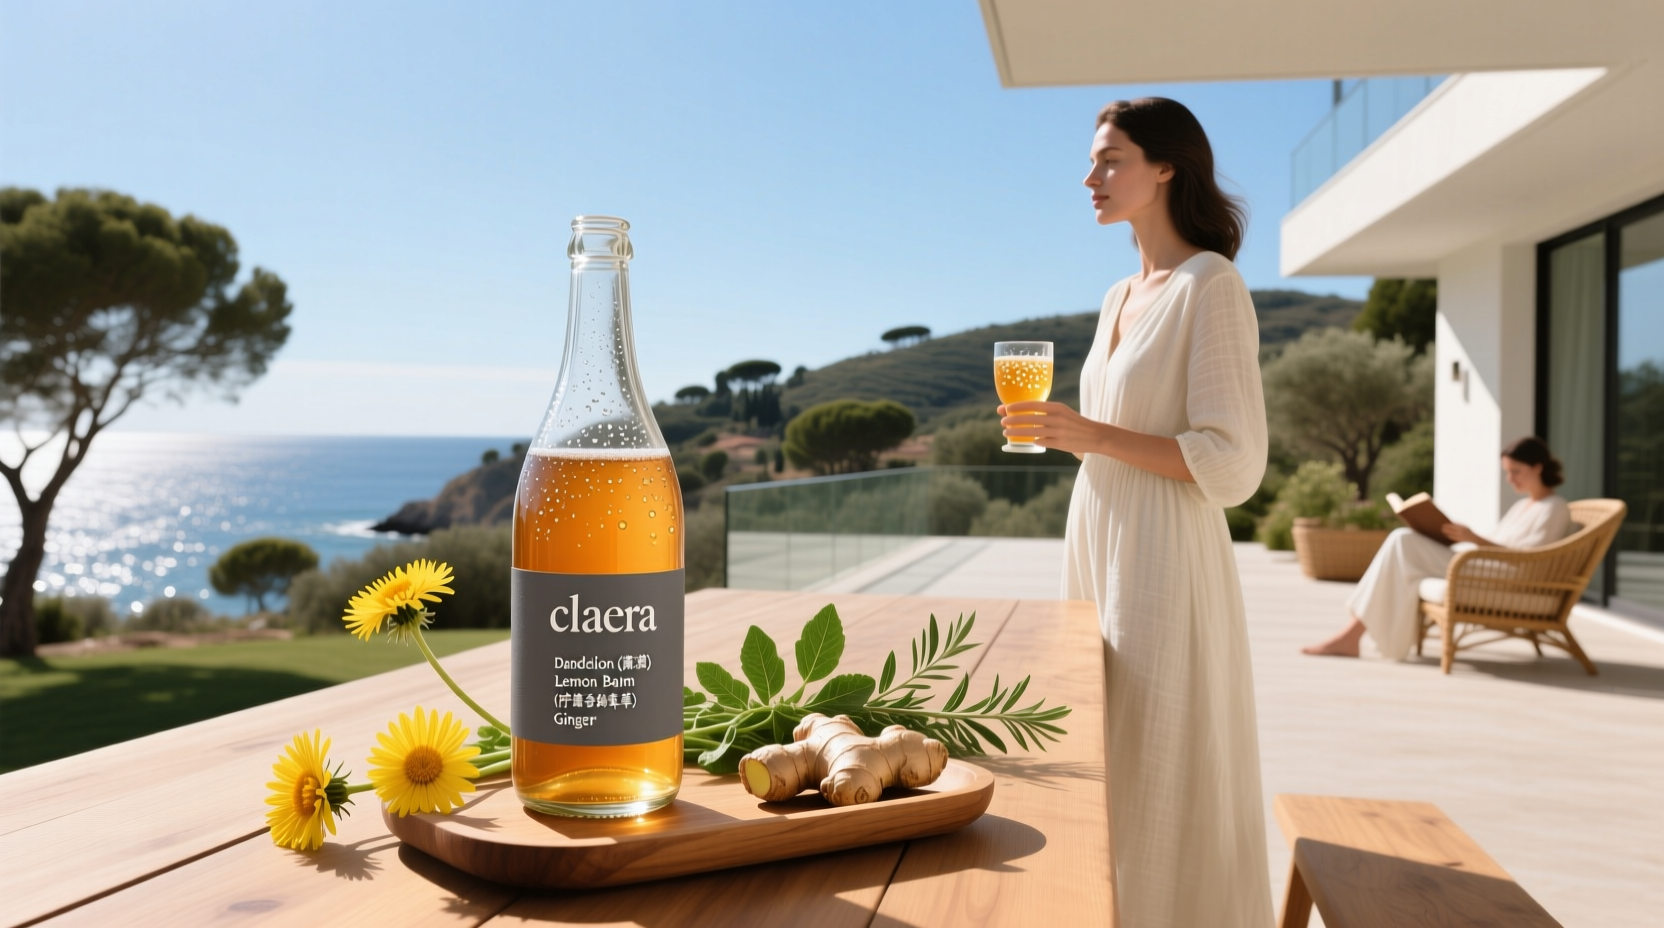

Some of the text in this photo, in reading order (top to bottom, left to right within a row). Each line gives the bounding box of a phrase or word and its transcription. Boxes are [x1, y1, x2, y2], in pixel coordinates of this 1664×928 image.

[549, 593, 658, 633] claera
[554, 674, 598, 688] Lemon
[553, 712, 597, 729] Ginger
